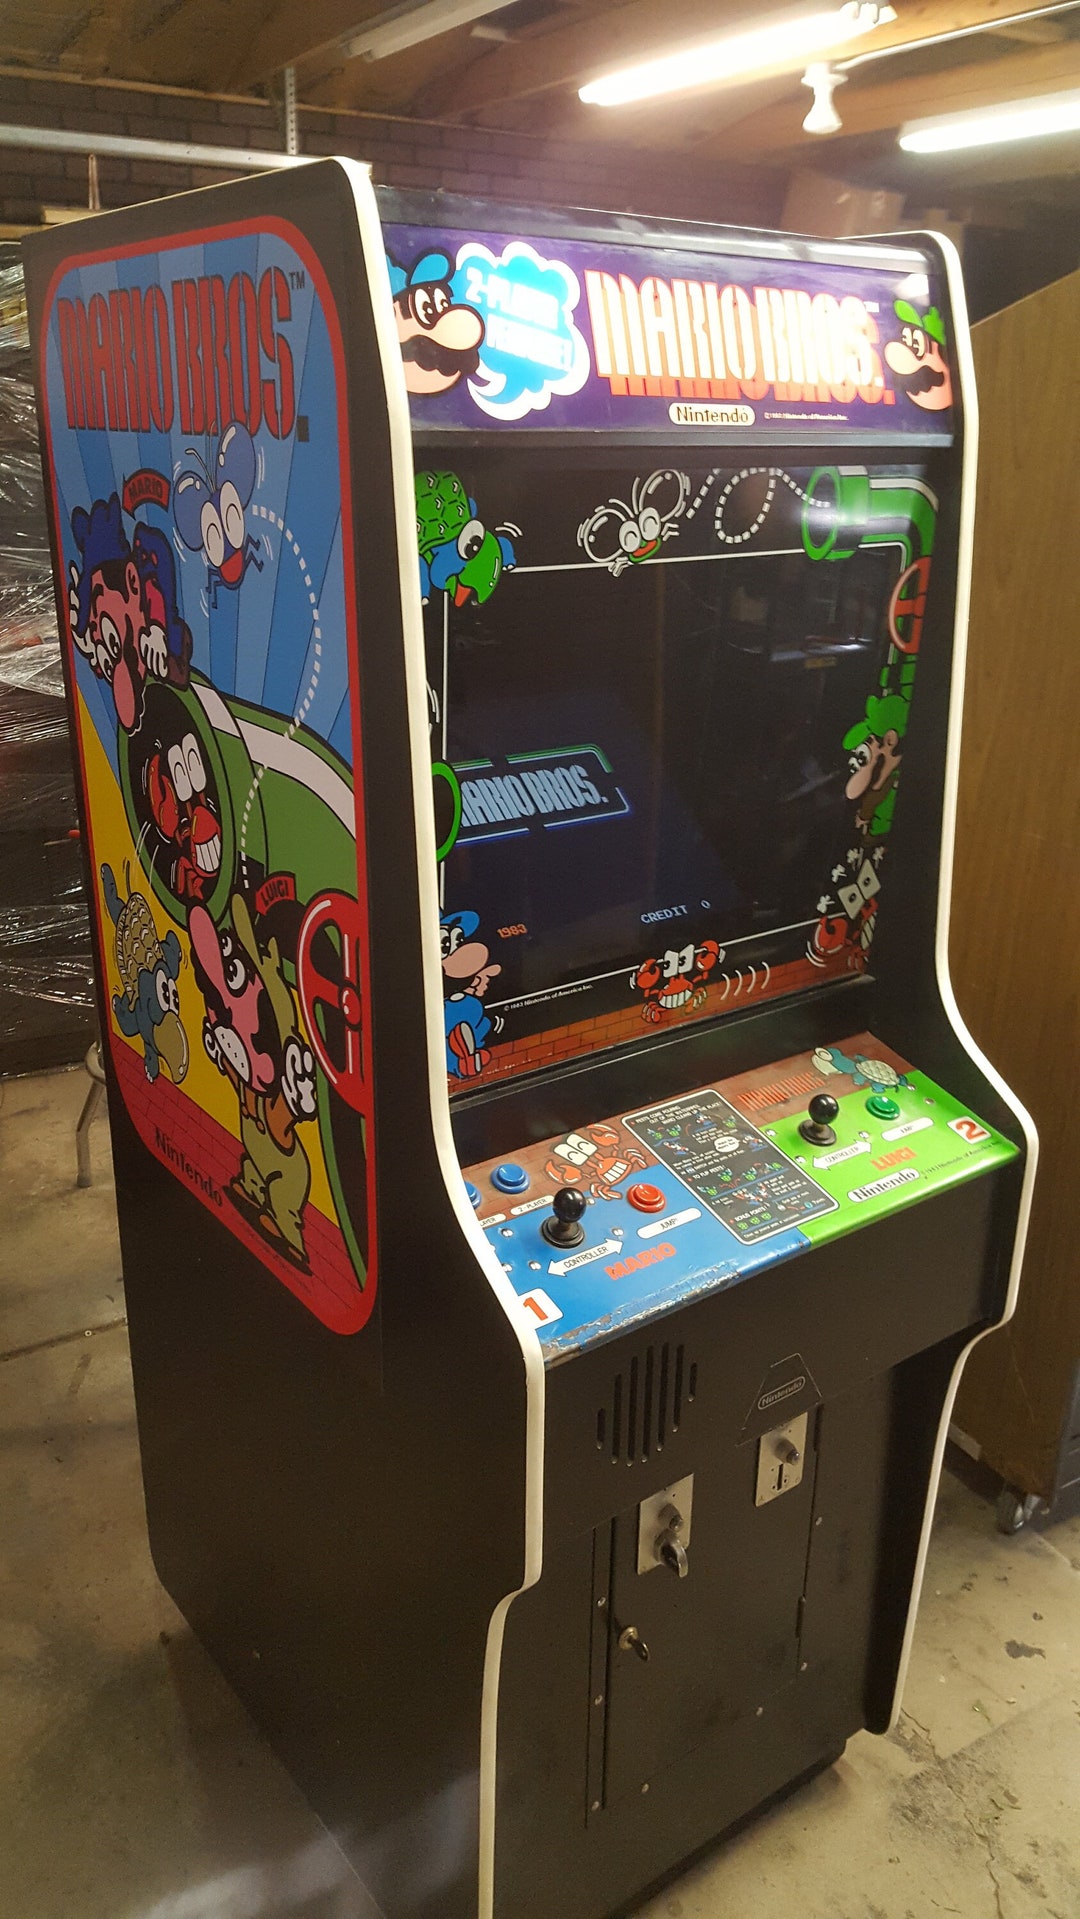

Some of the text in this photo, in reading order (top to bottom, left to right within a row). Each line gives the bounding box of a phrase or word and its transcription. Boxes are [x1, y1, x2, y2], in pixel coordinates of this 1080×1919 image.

[584, 269, 759, 392] MARIO
[57, 285, 174, 434] MARIO
[677, 406, 749, 423] Nintendo
[129, 477, 163, 502] MARIO
[520, 765, 609, 814] BROS.
[260, 879, 289, 907] LUIGI
[640, 905, 687, 924] CREDIT
[497, 923, 528, 938] 1983
[955, 1120, 987, 1141] 2
[155, 1126, 223, 1207] Nintendo
[825, 1146, 860, 1163] CONTROLLER
[870, 1146, 917, 1171] LUIGI
[853, 1171, 916, 1200] Nintendo
[564, 1247, 609, 1269] CONTROLLER
[604, 1242, 677, 1281] MARIO
[523, 1297, 548, 1321] 1
[762, 1381, 802, 1406] Nintendo
